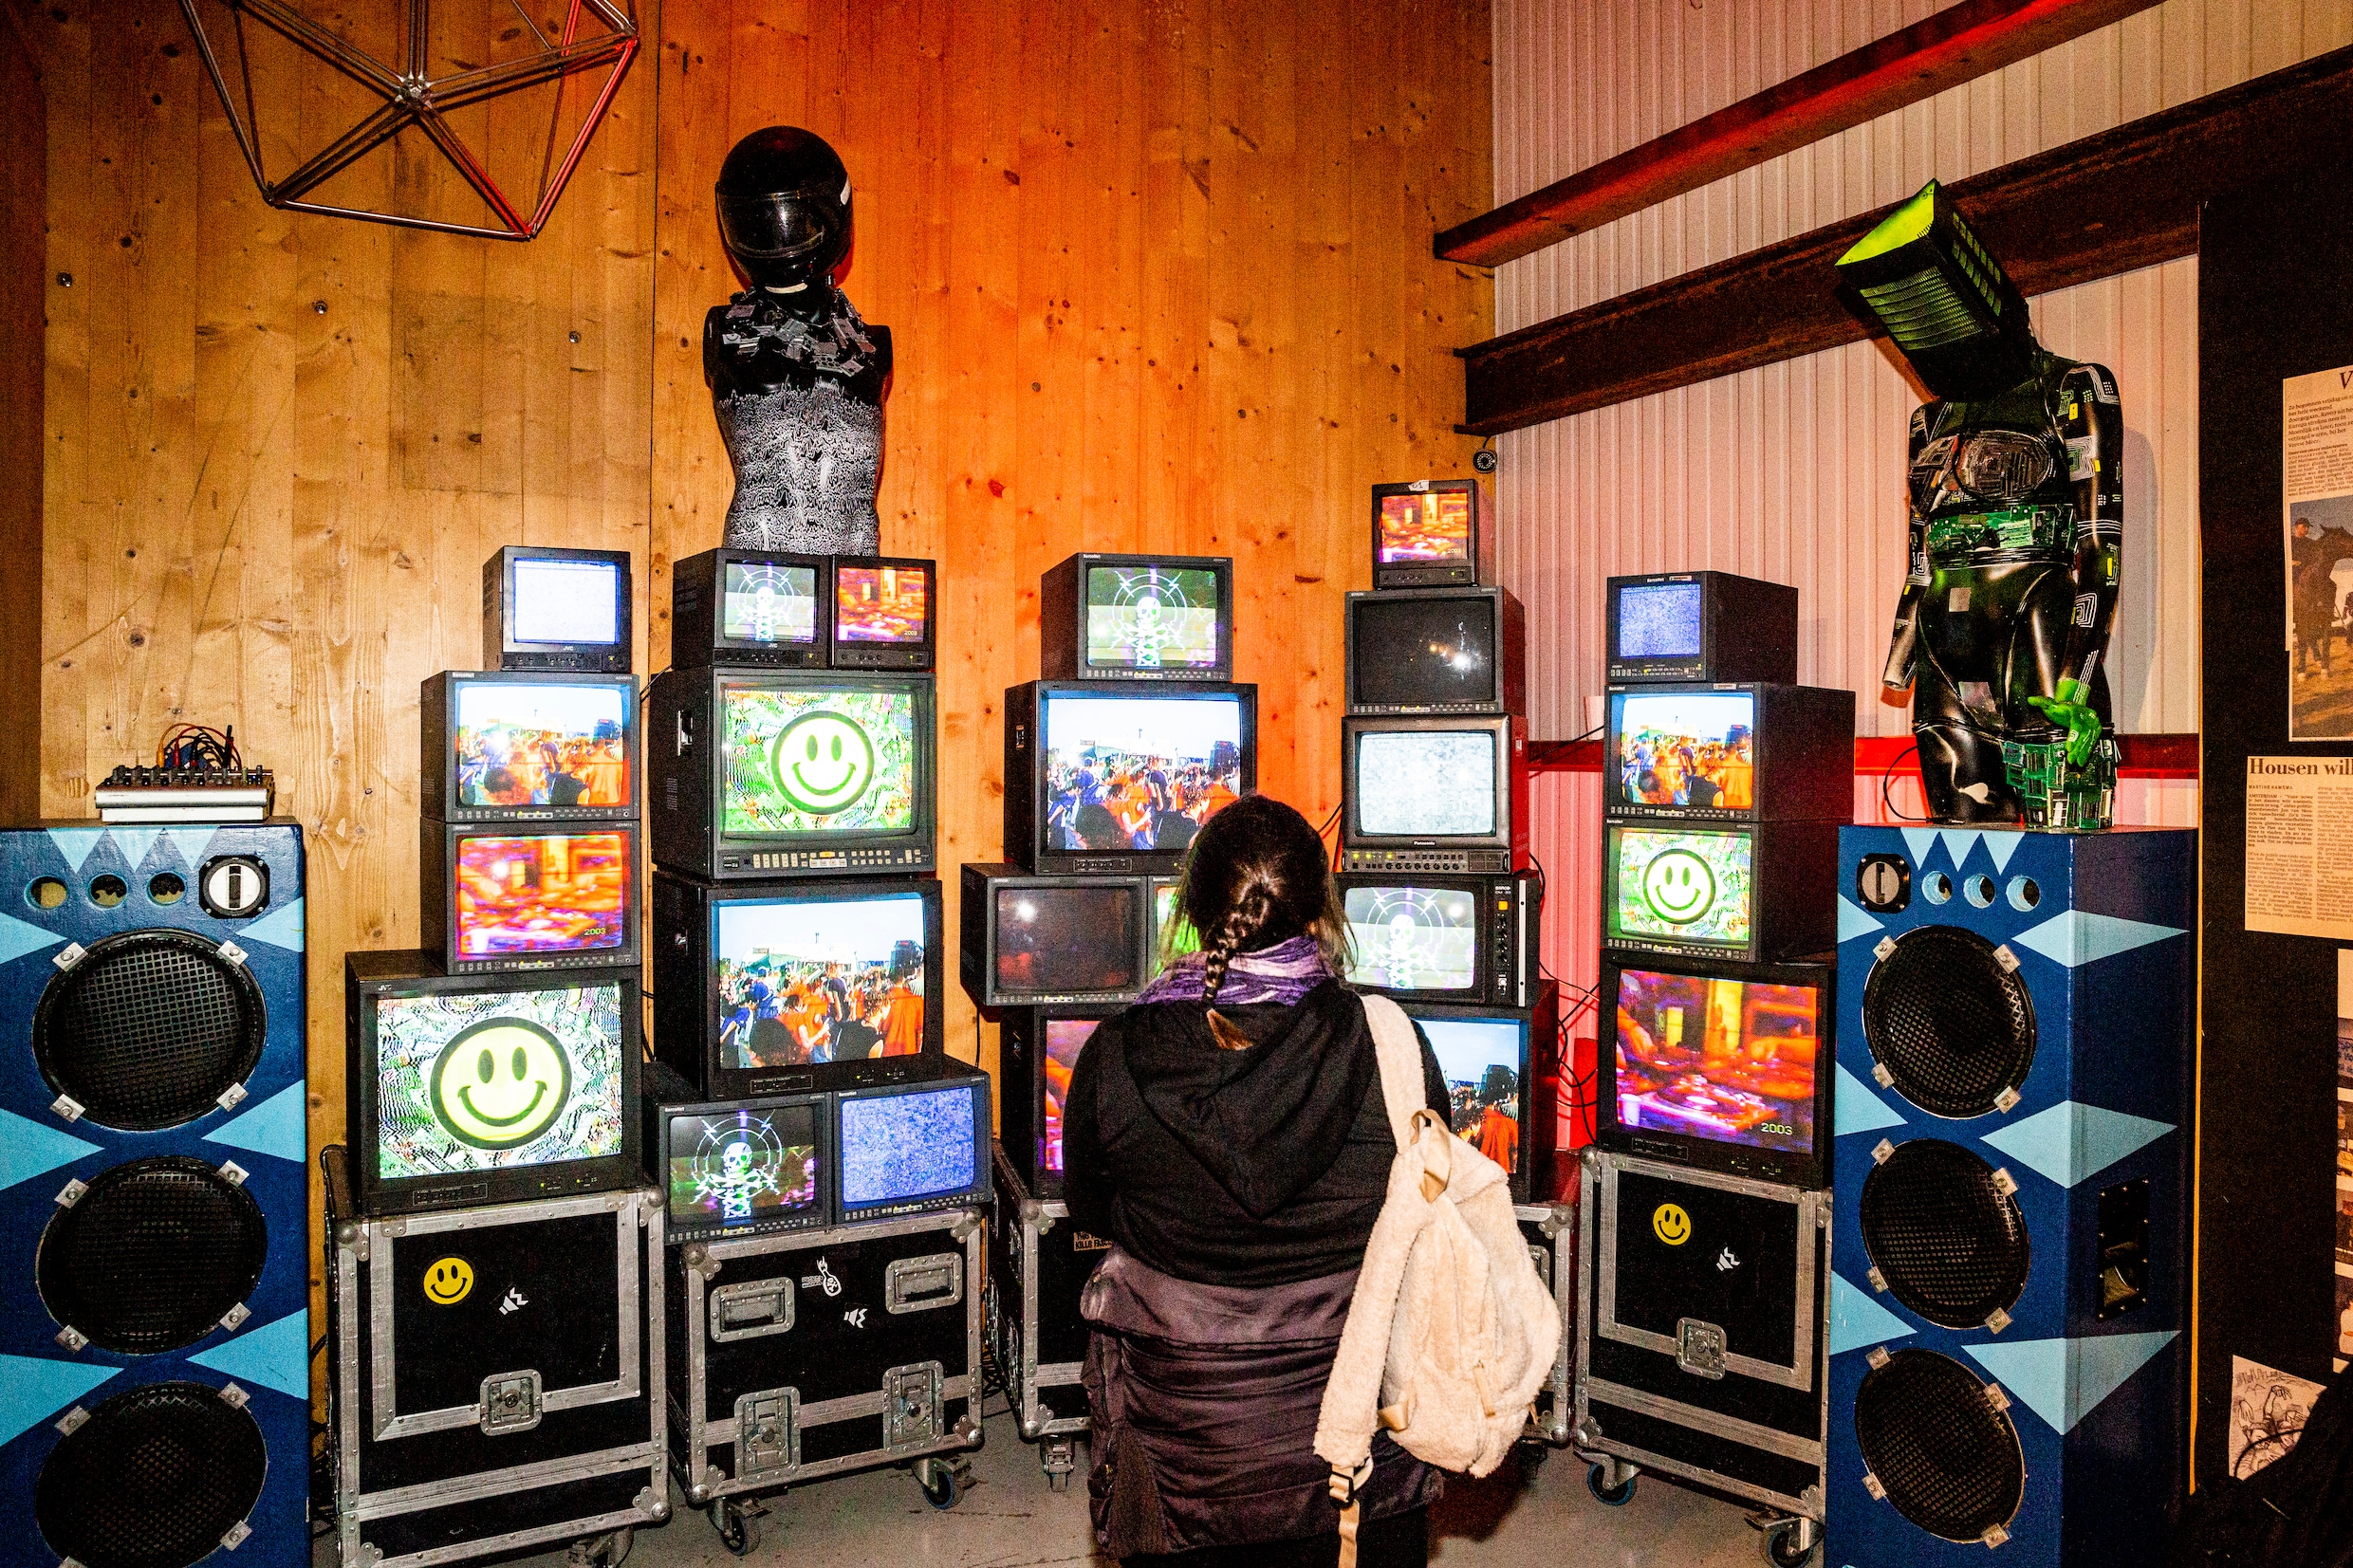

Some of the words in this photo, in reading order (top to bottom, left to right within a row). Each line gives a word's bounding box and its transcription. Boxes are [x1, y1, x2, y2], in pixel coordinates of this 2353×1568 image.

[2250, 758, 2318, 775] Housen
[584, 928, 606, 936] 2003
[1761, 1123, 1793, 1135] 2003
